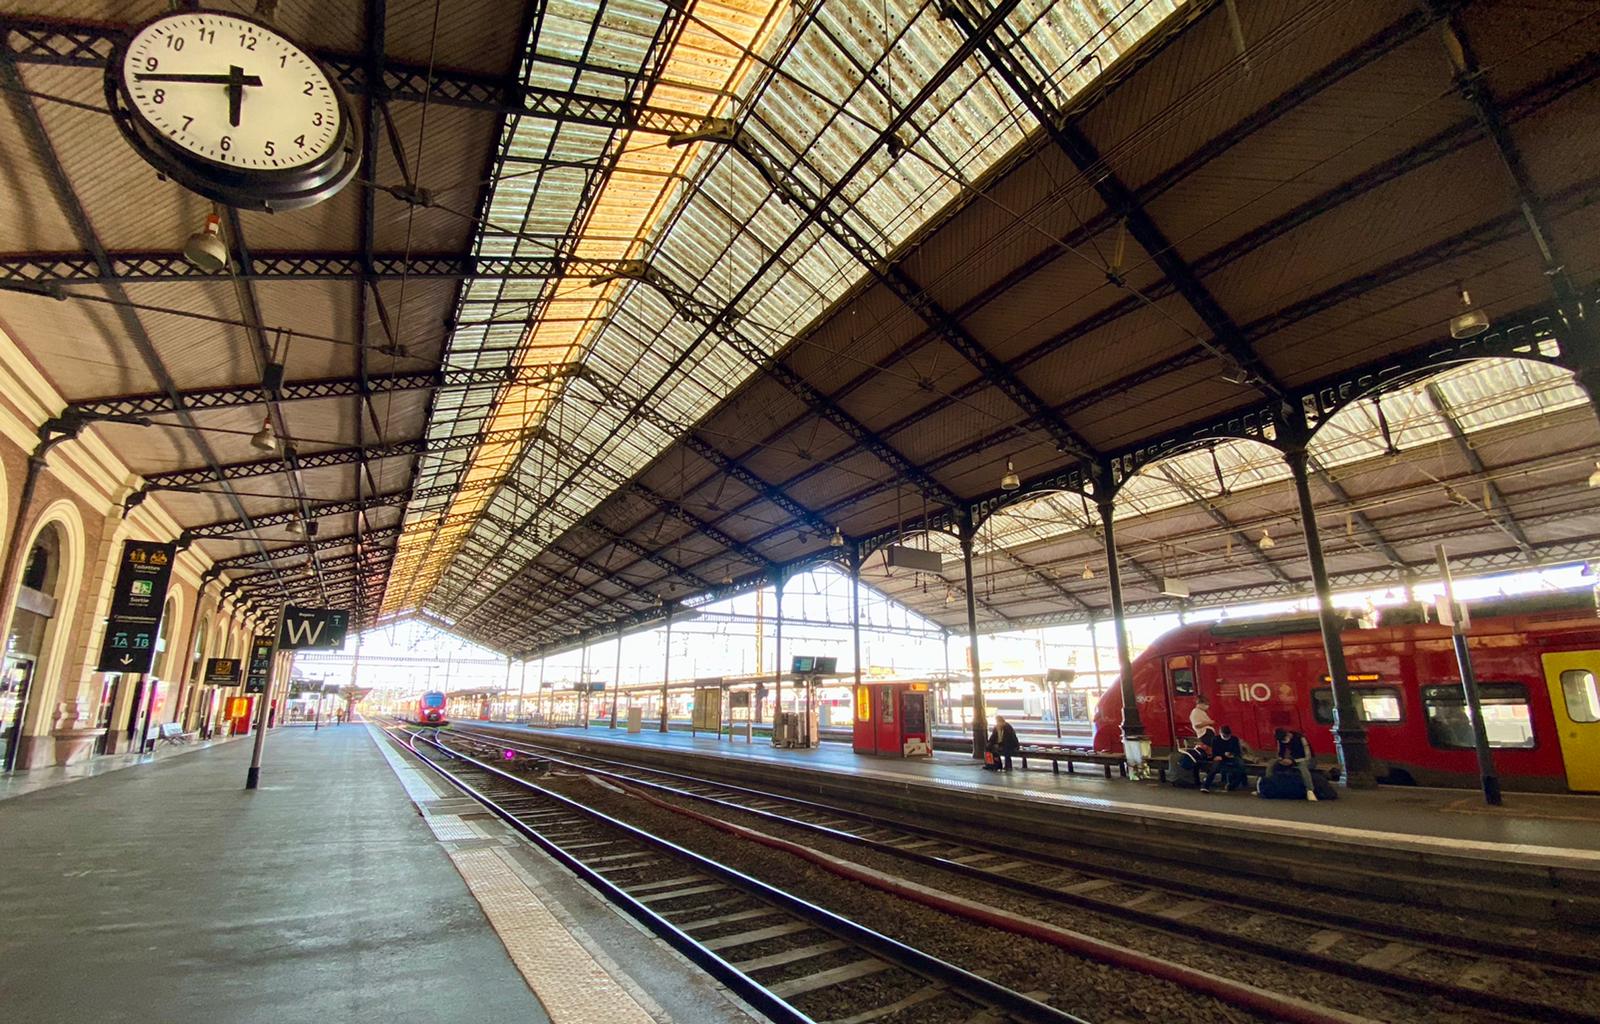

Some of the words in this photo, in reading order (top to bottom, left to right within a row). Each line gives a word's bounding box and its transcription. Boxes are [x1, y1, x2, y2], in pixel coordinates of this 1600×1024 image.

[166, 35, 184, 51] 10
[198, 27, 215, 45] 11
[239, 34, 257, 51] 12
[145, 57, 158, 72] 9
[280, 55, 287, 68] 1
[302, 81, 314, 96] 2
[152, 89, 165, 104] 8
[182, 115, 194, 132] 7
[312, 112, 323, 127] 3
[220, 136, 232, 151] 6
[264, 141, 275, 157] 5
[294, 134, 305, 149] 4
[287, 619, 325, 645] W
[112, 637, 128, 647] 1A
[134, 638, 149, 647] 1B
